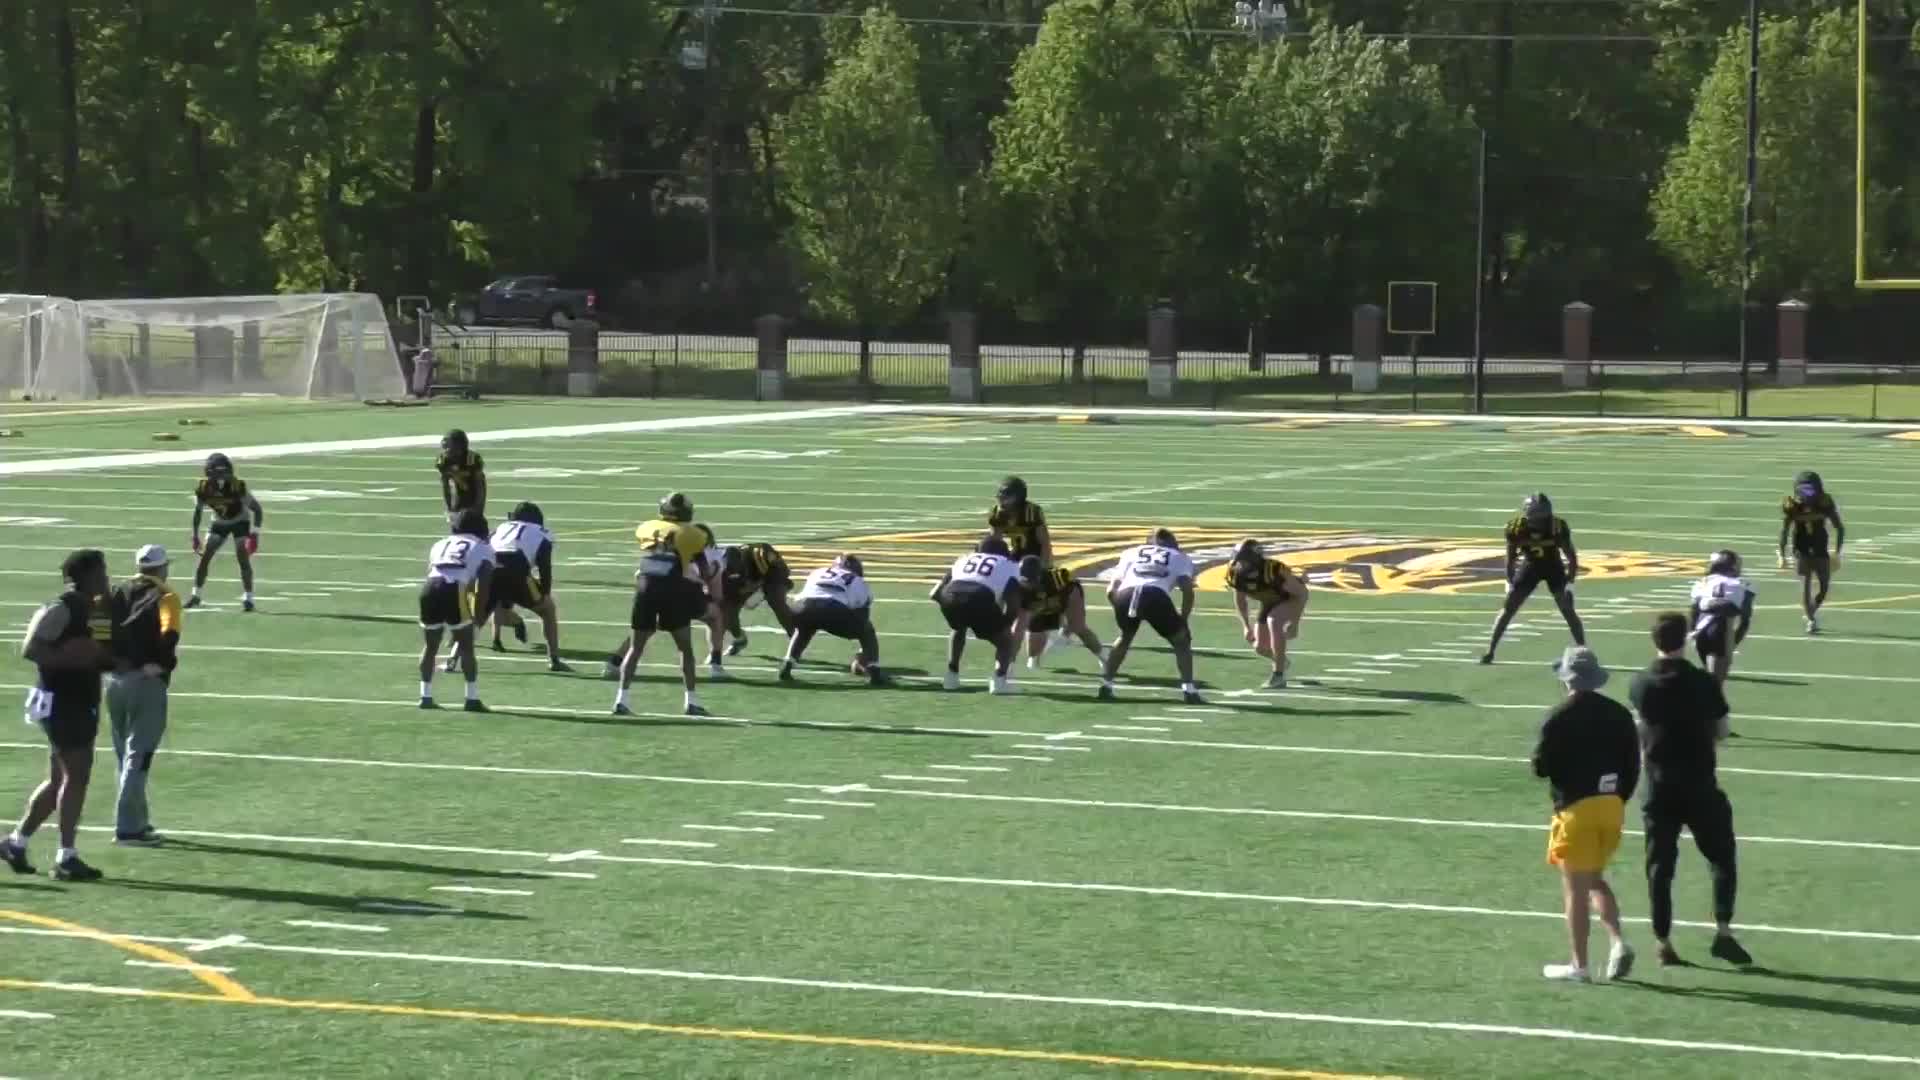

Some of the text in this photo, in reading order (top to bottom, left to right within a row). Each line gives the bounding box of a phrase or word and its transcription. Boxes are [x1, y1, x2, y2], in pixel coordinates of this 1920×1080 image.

[440, 540, 470, 564] 13
[1136, 547, 1170, 566] 53
[963, 555, 997, 577] 66
